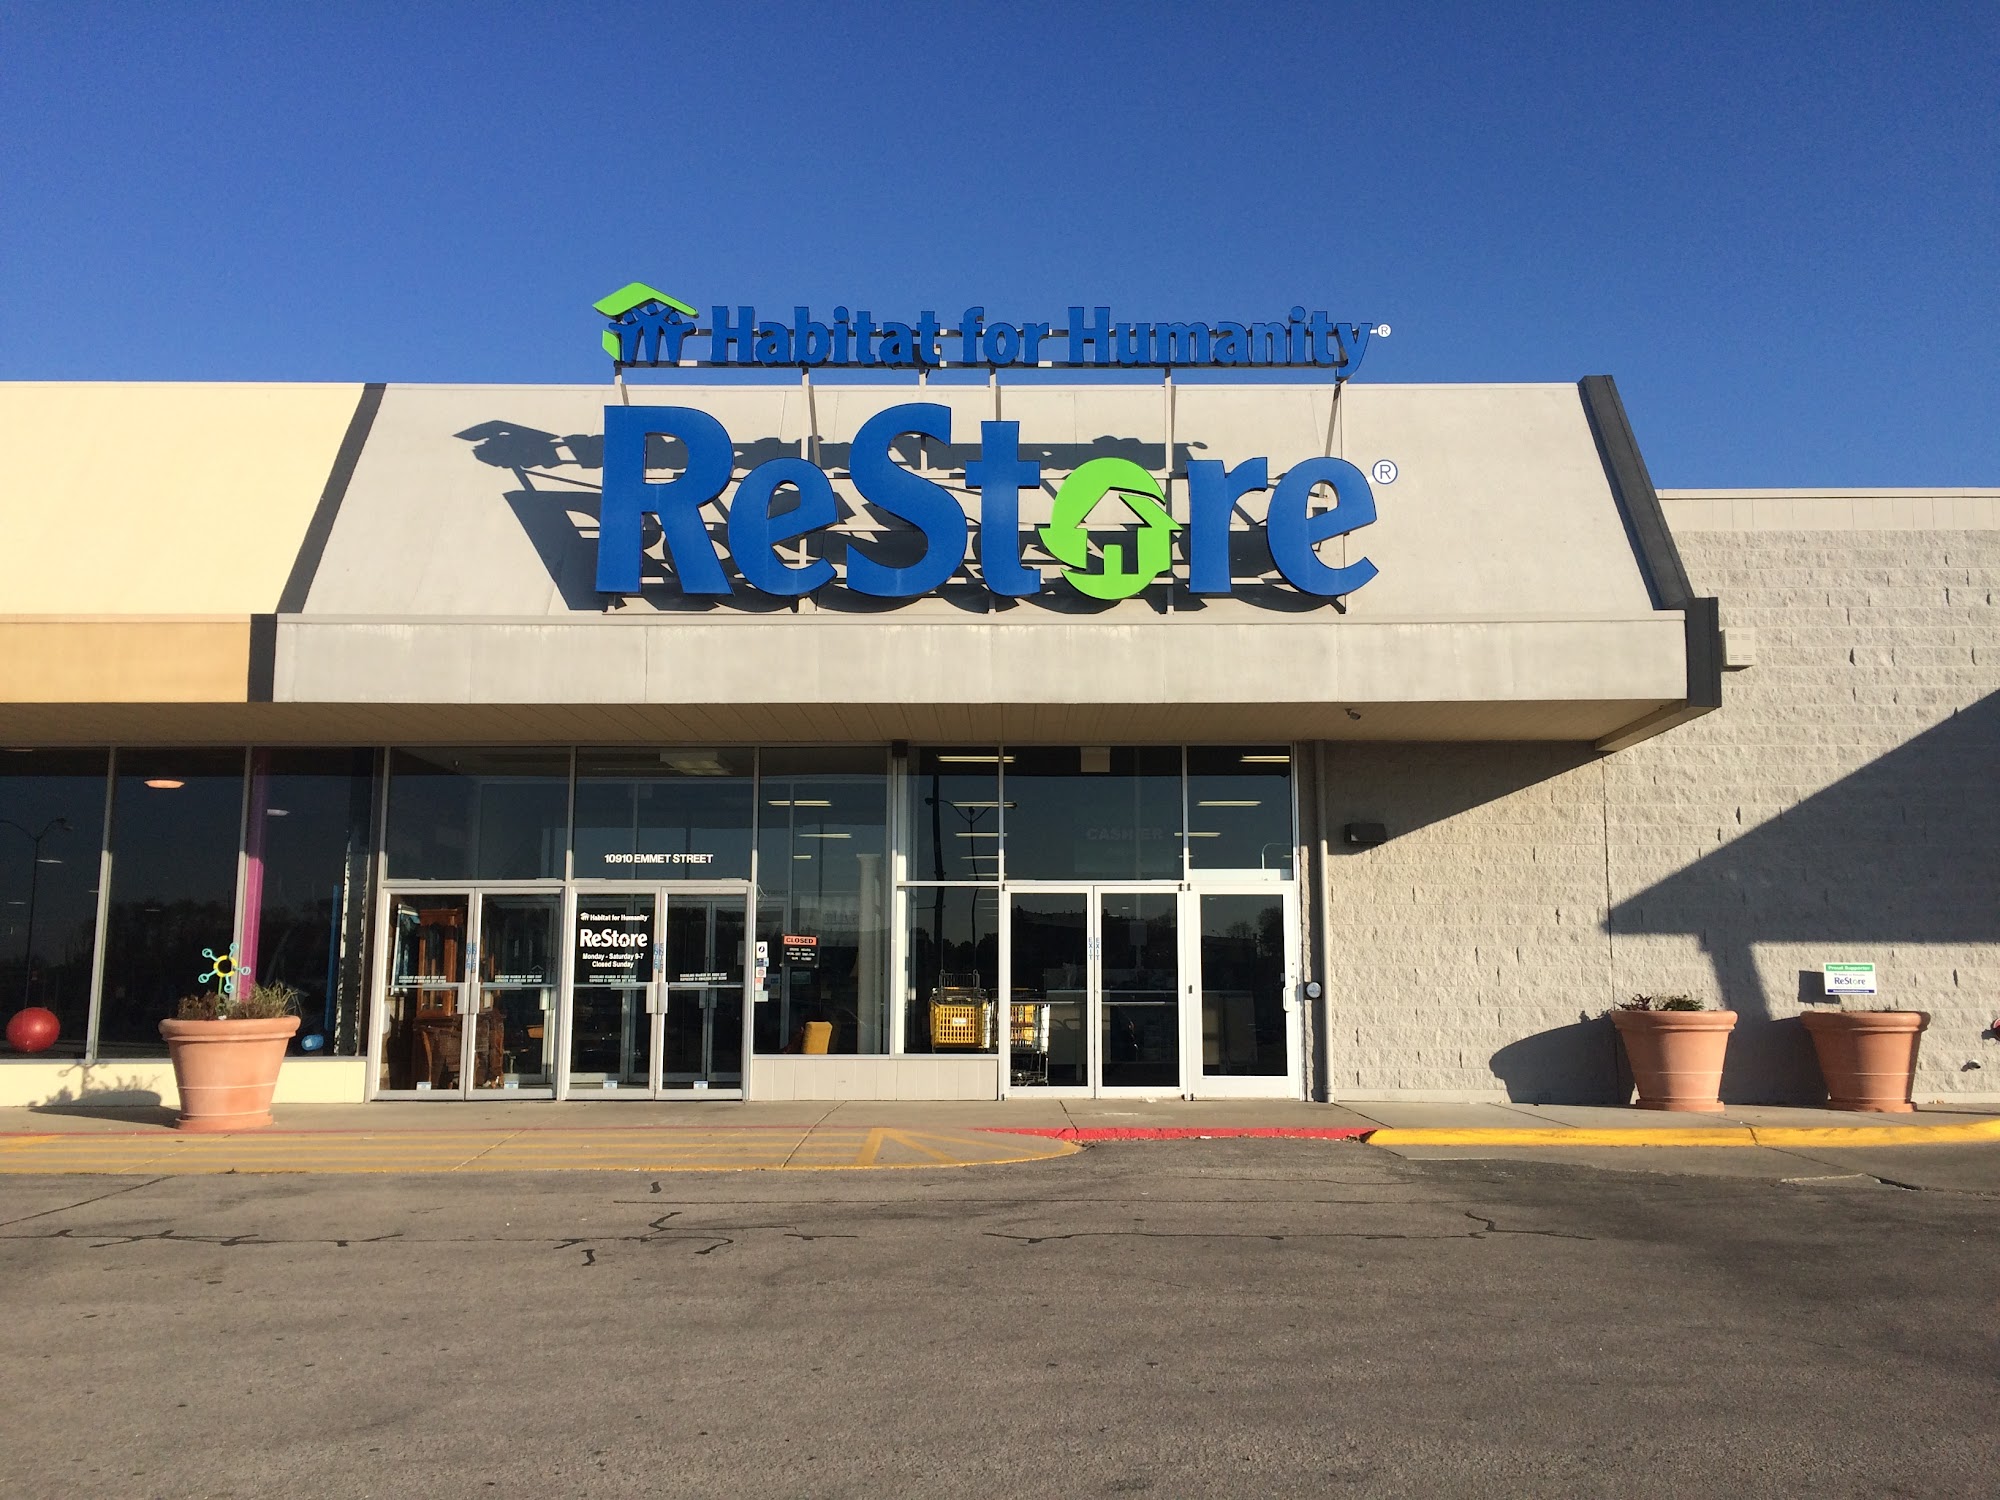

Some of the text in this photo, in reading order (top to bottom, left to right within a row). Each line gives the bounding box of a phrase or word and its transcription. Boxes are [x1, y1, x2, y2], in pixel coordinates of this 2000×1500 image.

[711, 305, 1374, 380] Habitat for Humanity
[595, 402, 1381, 602] ReStore
[604, 853, 714, 864] 10910 EMMET STREET
[620, 914, 648, 922] Humanity
[580, 928, 648, 948] ReStore
[582, 953, 605, 961] Monday
[609, 953, 634, 961] Saturday
[612, 961, 634, 969] Sunday
[1834, 976, 1866, 985] ReStore
